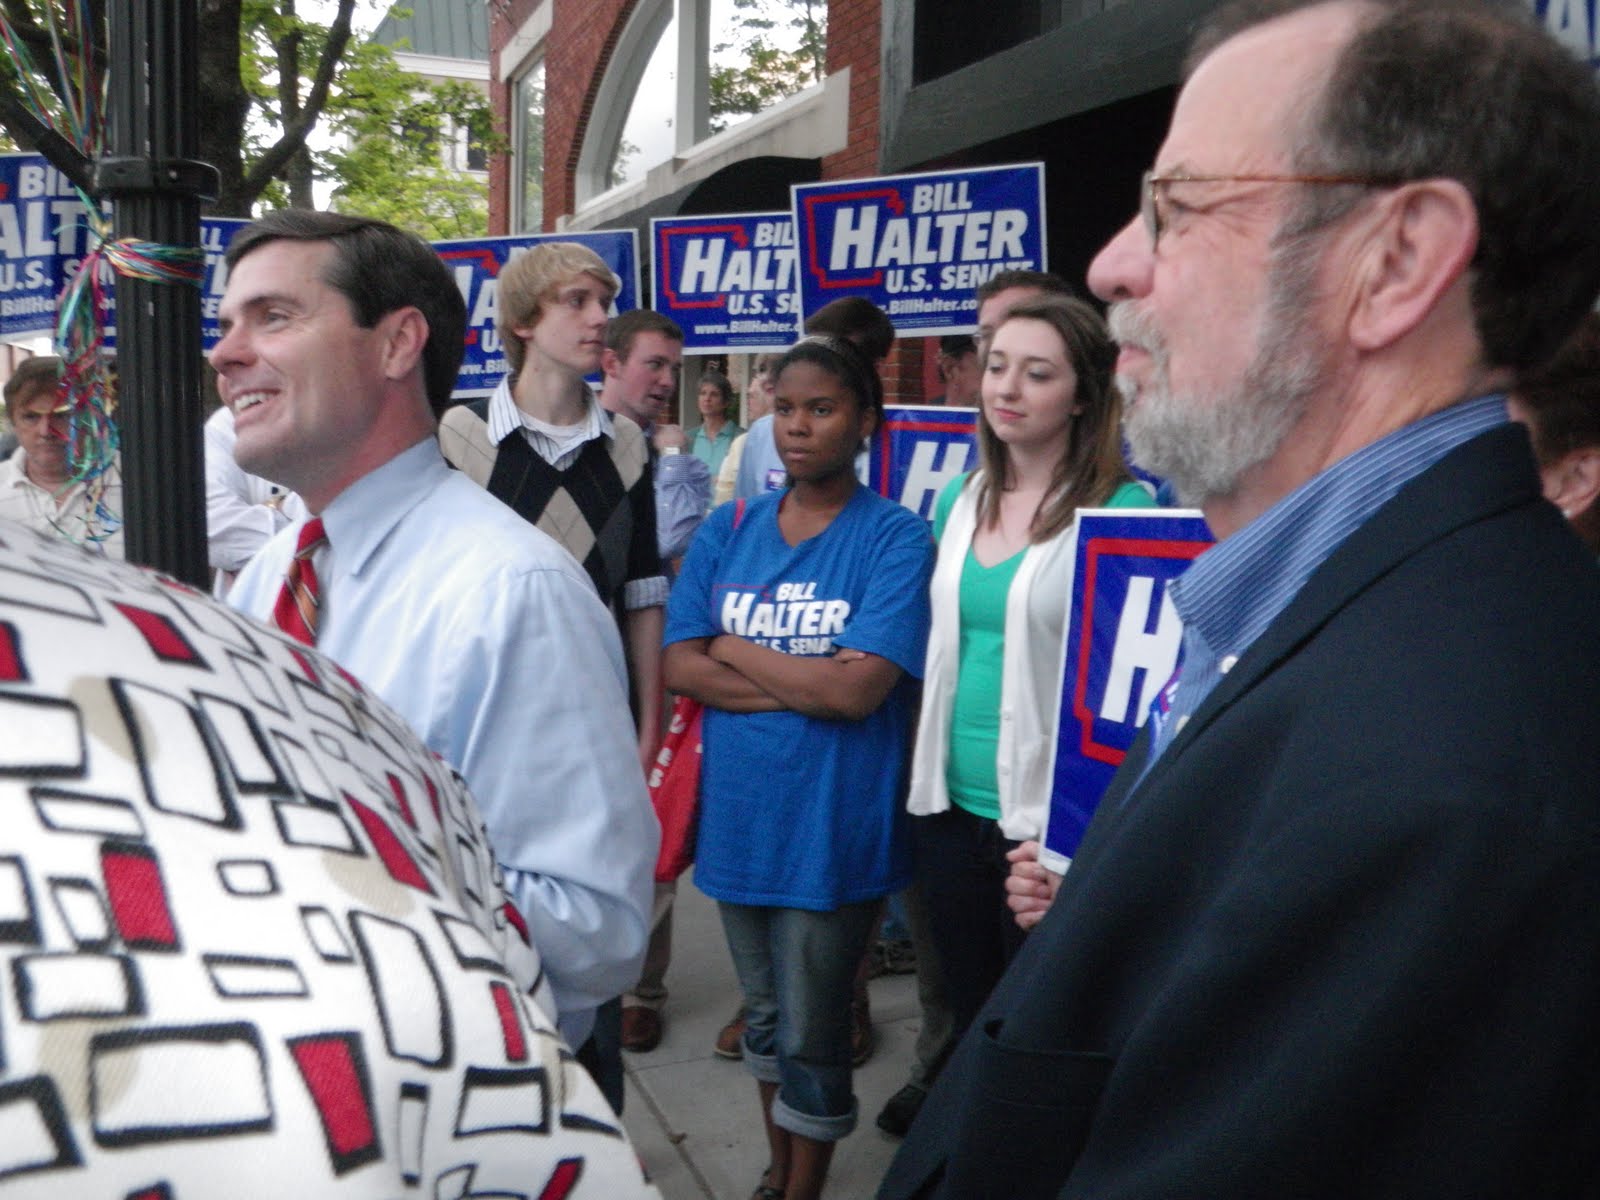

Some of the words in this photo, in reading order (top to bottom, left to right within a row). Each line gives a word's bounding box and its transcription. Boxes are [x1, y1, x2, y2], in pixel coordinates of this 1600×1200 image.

[19, 165, 76, 198] BIL
[912, 181, 972, 214] BILL
[754, 222, 794, 247] BIL
[829, 205, 1028, 270] HALTER
[0, 260, 54, 292] U.S.
[679, 238, 797, 293] HALT
[886, 268, 933, 294] U.S.
[727, 294, 770, 315] U.S.
[776, 582, 818, 601] BILL
[721, 592, 850, 637] HALTER
[788, 637, 834, 655] SENA
